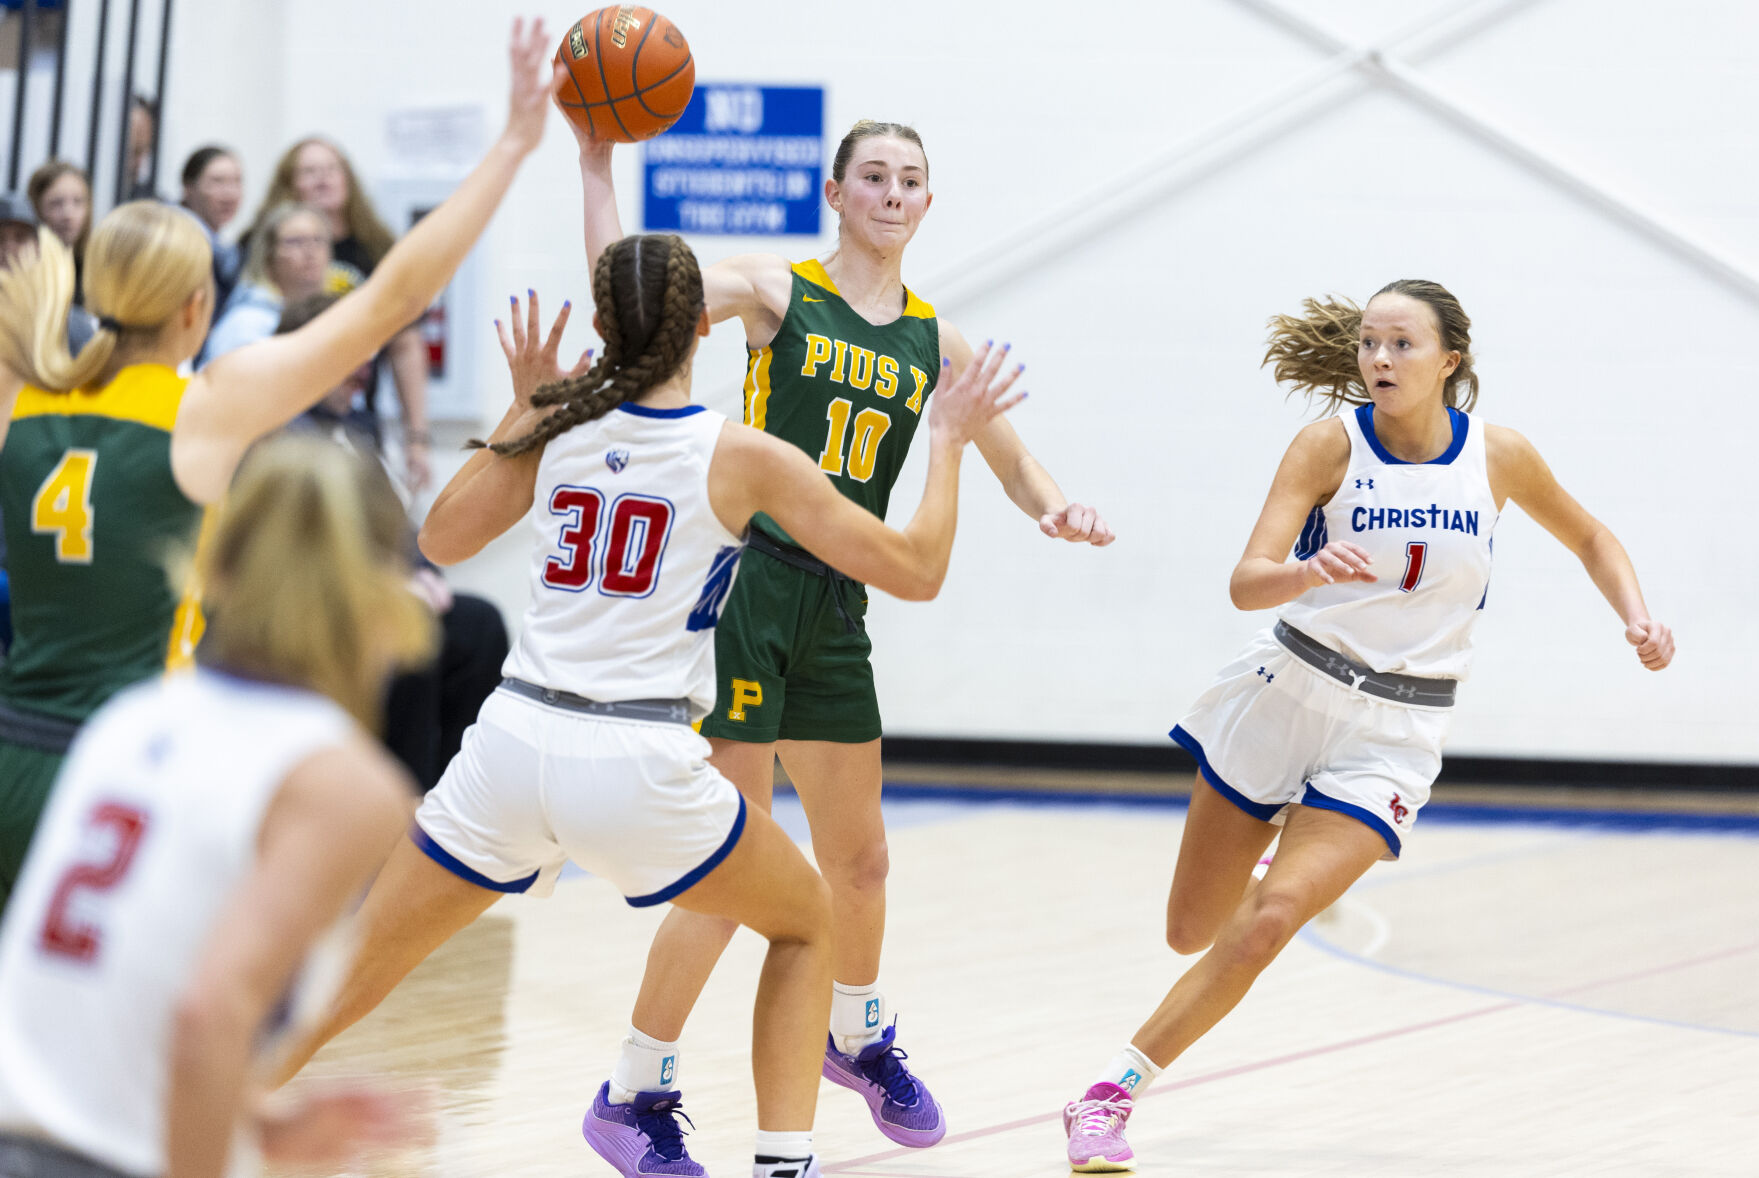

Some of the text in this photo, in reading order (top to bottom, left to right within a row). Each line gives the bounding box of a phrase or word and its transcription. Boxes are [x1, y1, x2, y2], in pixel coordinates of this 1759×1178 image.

[706, 89, 763, 132] NO
[801, 333, 928, 416] PIUS X
[818, 396, 892, 484] 10
[32, 448, 98, 564] 4
[541, 484, 675, 599] 30
[1352, 503, 1479, 537] CHRISTIAN
[1398, 541, 1428, 594] 1
[727, 677, 763, 722] P
[36, 796, 152, 966] 2
